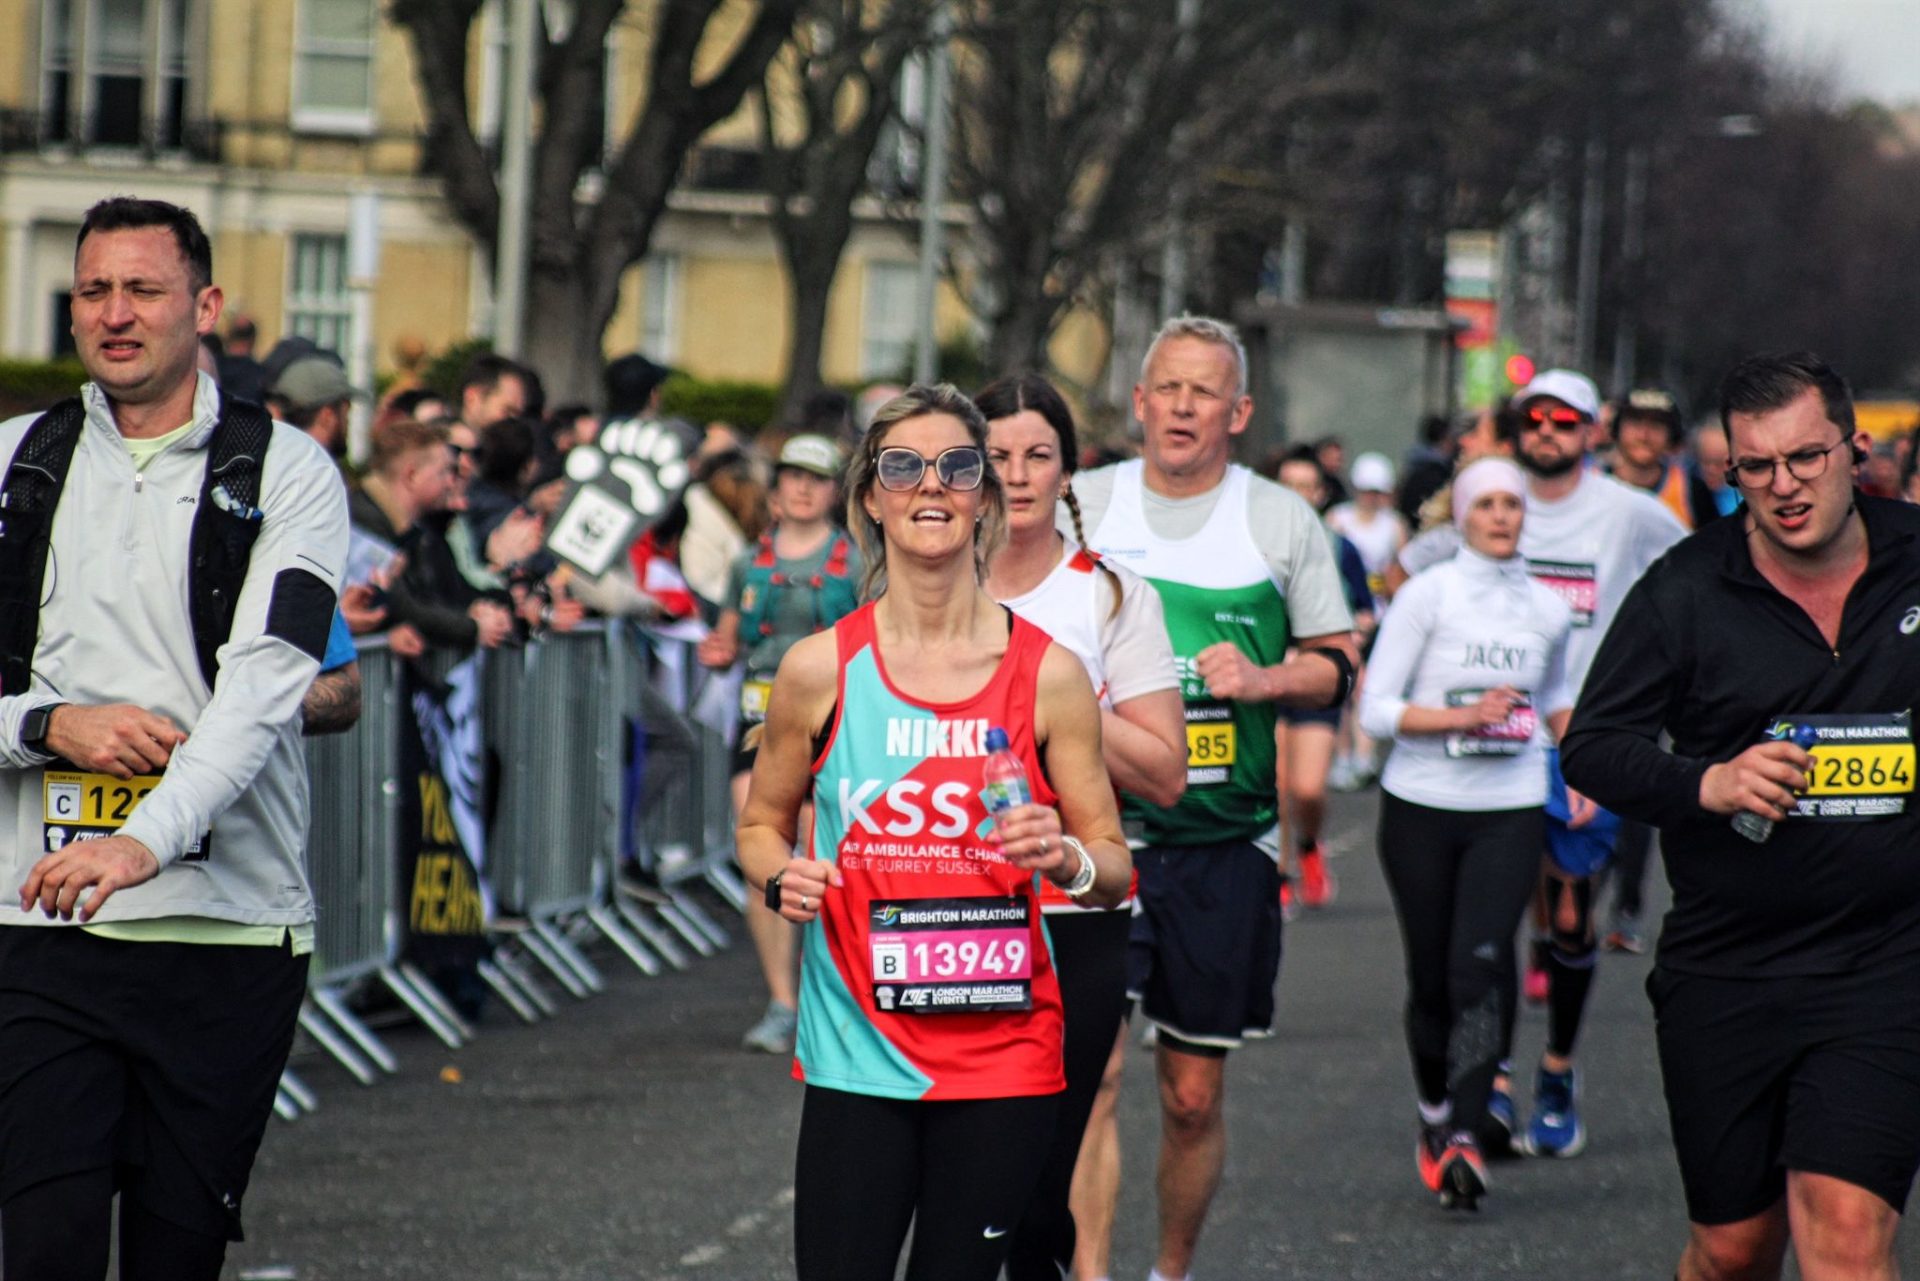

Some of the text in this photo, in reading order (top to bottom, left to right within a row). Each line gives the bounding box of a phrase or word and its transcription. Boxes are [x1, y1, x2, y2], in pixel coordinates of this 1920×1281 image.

[886, 718, 990, 758] NIKKI
[1847, 726, 1908, 738] MARATHON
[1187, 735, 1228, 760] 85
[56, 795, 71, 815] C
[838, 778, 972, 838] KSS
[863, 843, 961, 859] AMBULANCE
[877, 859, 932, 874] SURREY
[936, 861, 991, 876] SUSSEX
[900, 909, 1025, 924] BRIGHTON MARATHON
[883, 956, 897, 974] B
[913, 940, 1026, 976] 13949
[932, 988, 971, 997] LONDON
[972, 985, 1022, 995] MARATHON
[932, 995, 967, 1005] EVENTS
